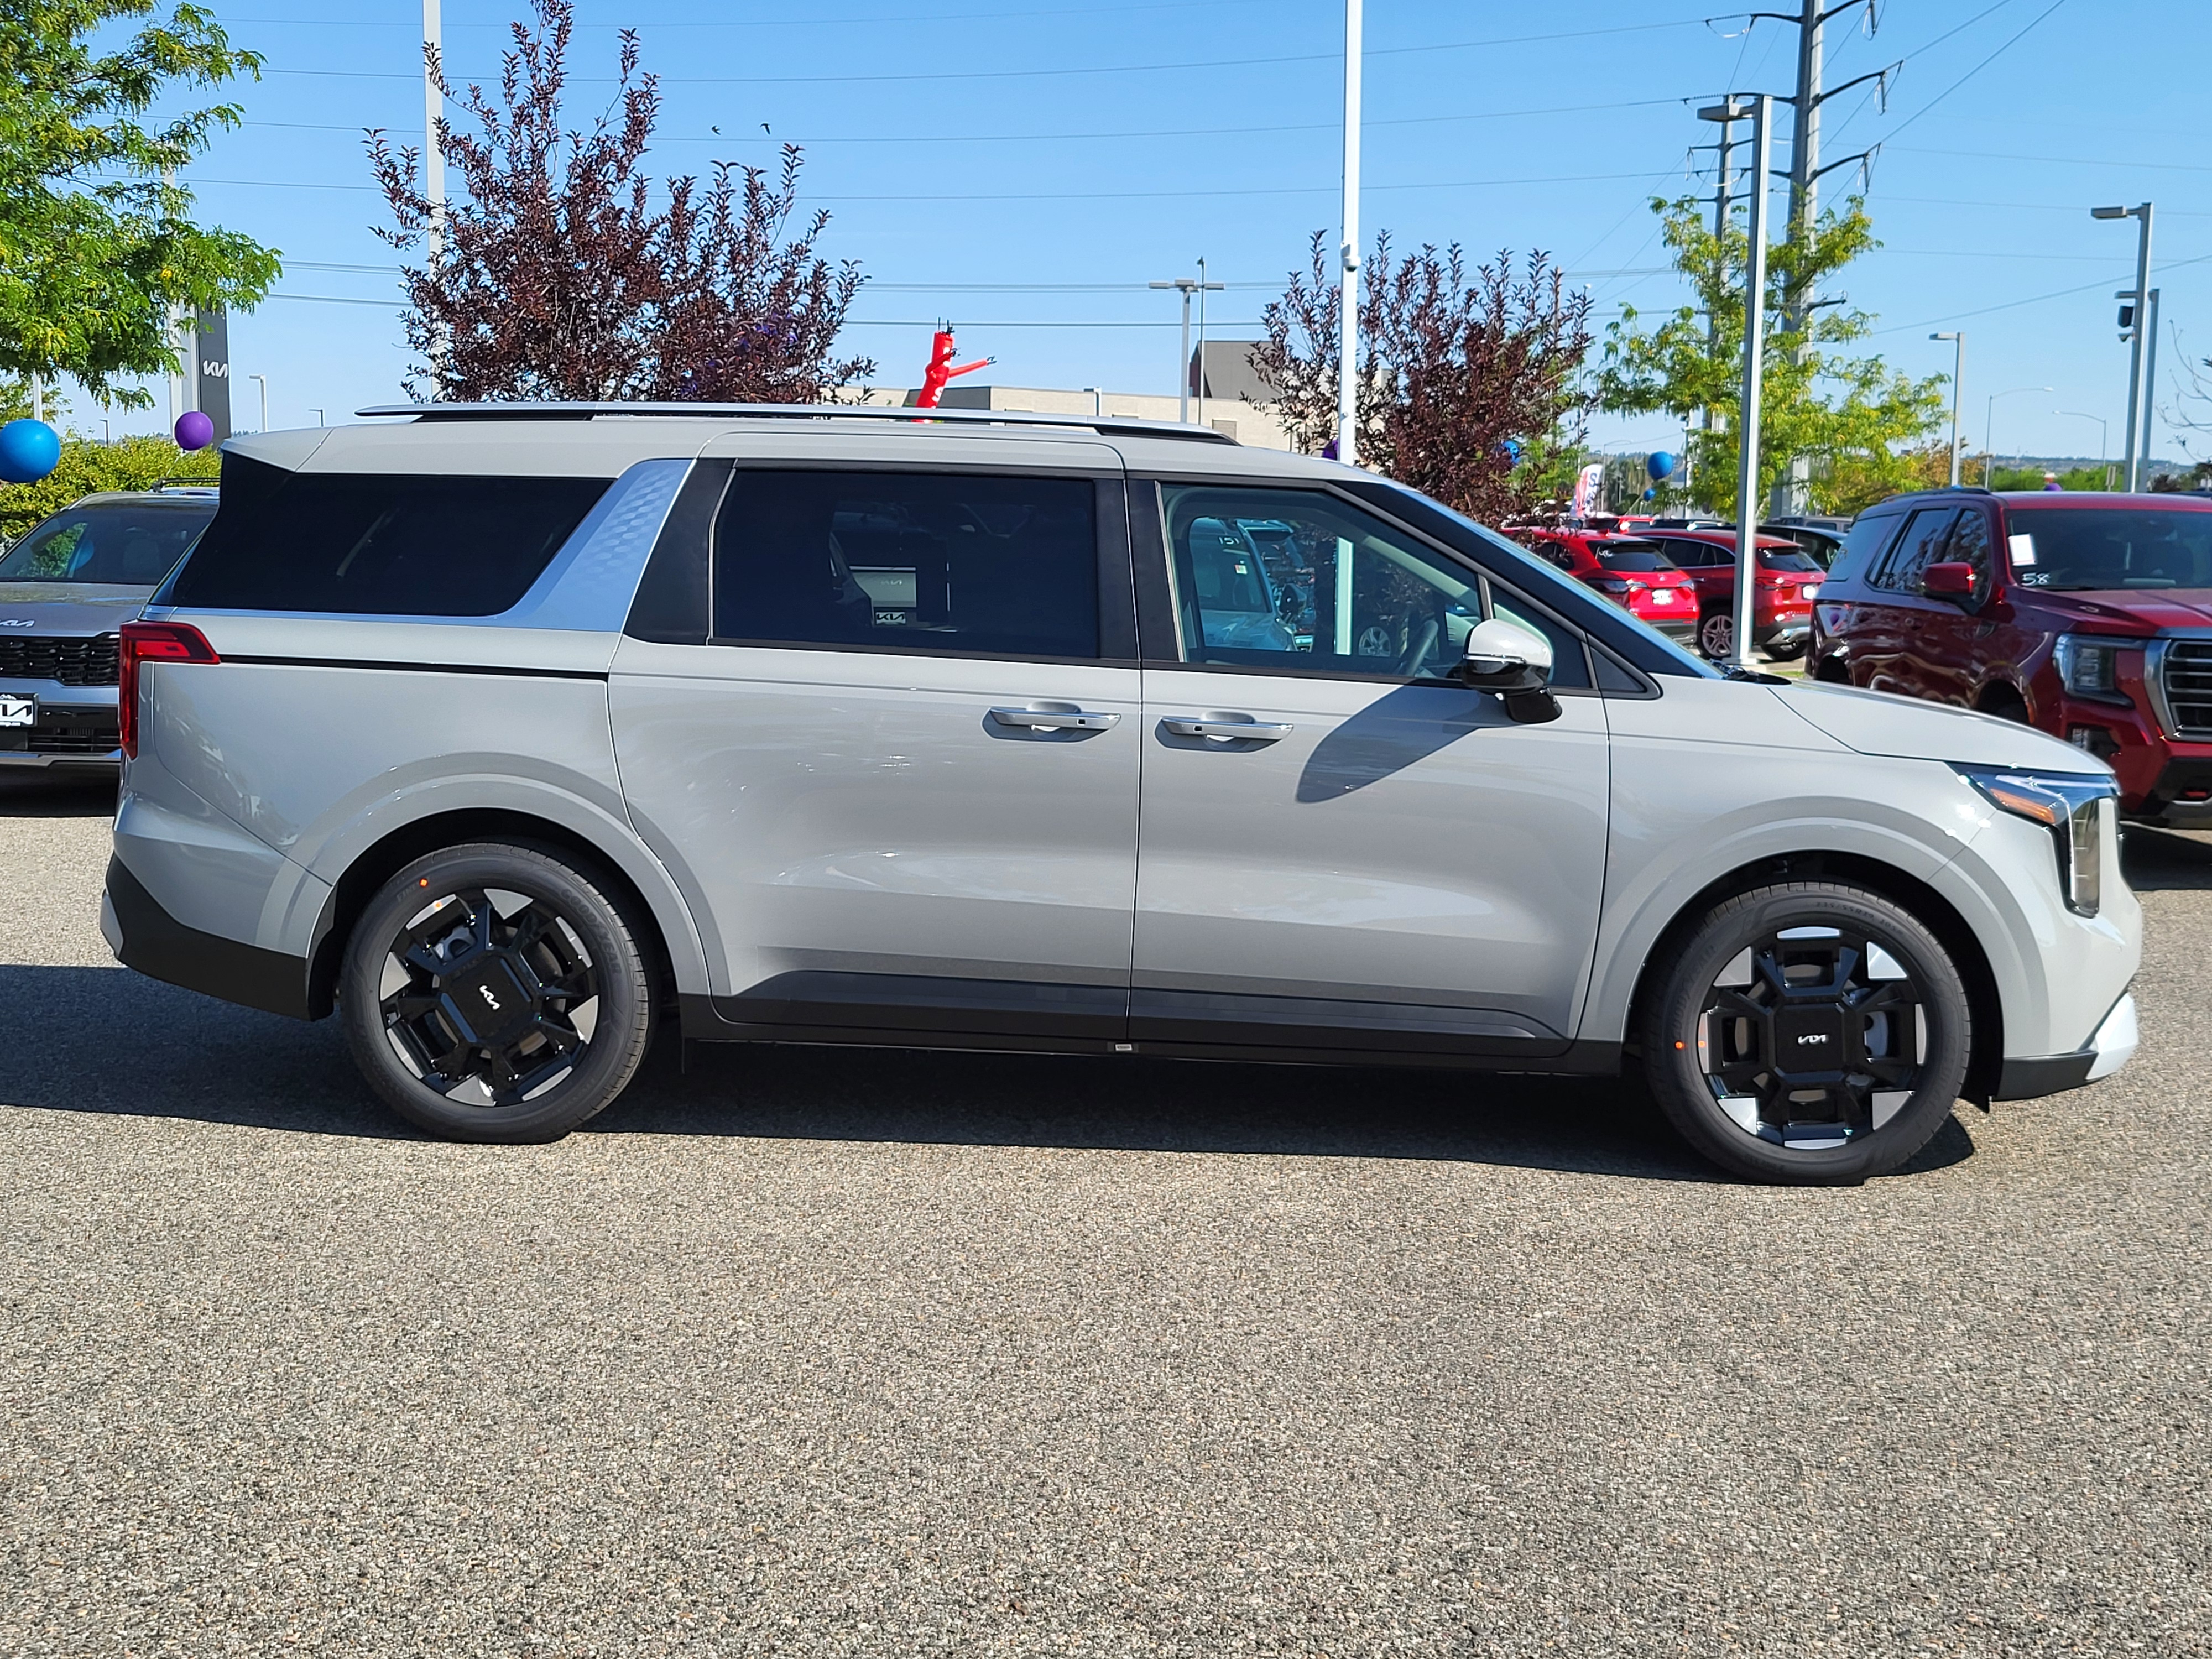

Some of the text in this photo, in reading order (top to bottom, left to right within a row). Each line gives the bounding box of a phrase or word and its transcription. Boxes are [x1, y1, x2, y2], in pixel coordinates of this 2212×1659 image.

[203, 360, 228, 378] KIA
[2021, 573, 2049, 586] 58
[0, 703, 32, 717] IA
[560, 887, 622, 974] GOODYEAR
[479, 985, 500, 1010] KIA
[1798, 1034, 1828, 1045] KIA
